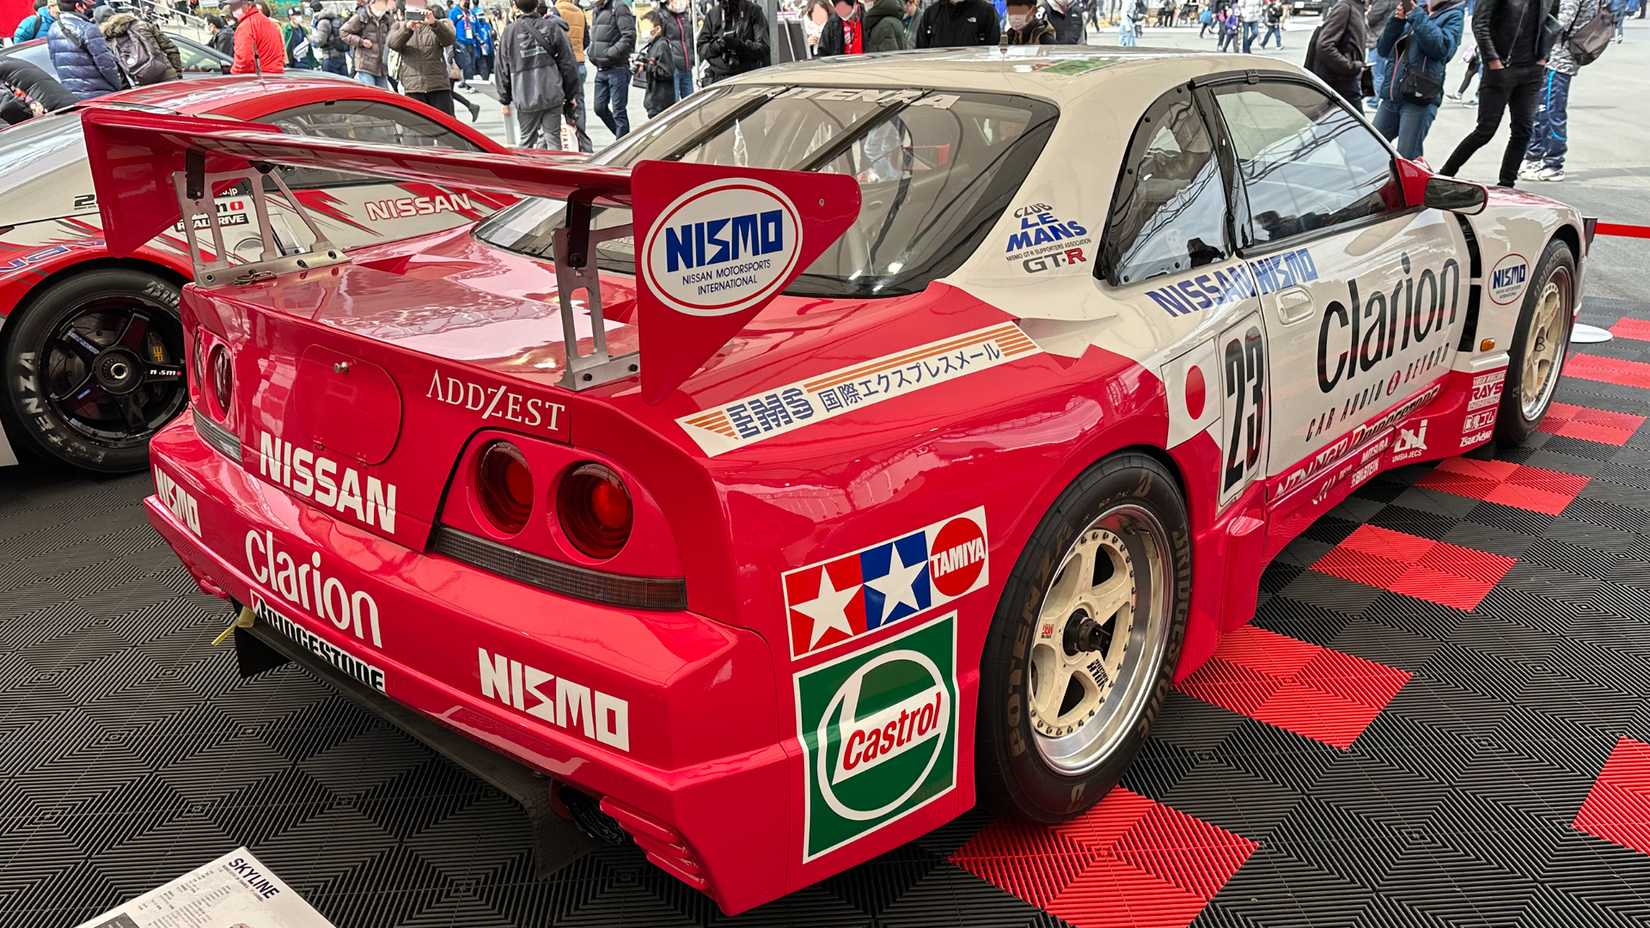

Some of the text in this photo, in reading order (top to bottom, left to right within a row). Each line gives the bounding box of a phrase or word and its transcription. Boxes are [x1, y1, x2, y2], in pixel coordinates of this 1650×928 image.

[365, 193, 472, 220] NISSAN
[1006, 220, 1087, 253] MANS
[1013, 203, 1053, 218] CLUB
[1021, 213, 1059, 230] LE
[665, 208, 784, 273] NISMO
[682, 258, 771, 286] NISSAN MOTORSPORTS
[697, 275, 758, 296] INTERNATIONAL
[1144, 248, 1319, 318] NISSAN NISMO
[1493, 264, 1526, 290] NISMO
[425, 369, 565, 431] ADDZEST
[726, 341, 1000, 440] EMS 国際エクスプレスメール
[1223, 325, 1264, 494] 23
[1305, 407, 1336, 442] CAR
[1340, 379, 1384, 423] AUDIO
[1472, 382, 1504, 400] RAYS
[154, 463, 203, 538] NISMO
[260, 430, 397, 535] NISSAN
[930, 537, 986, 579] TAMIYA
[250, 588, 387, 694] BRIDGESTONE
[478, 647, 630, 753] NISMO
[842, 692, 941, 771] Castrol
[228, 857, 280, 901] SKYLINE
